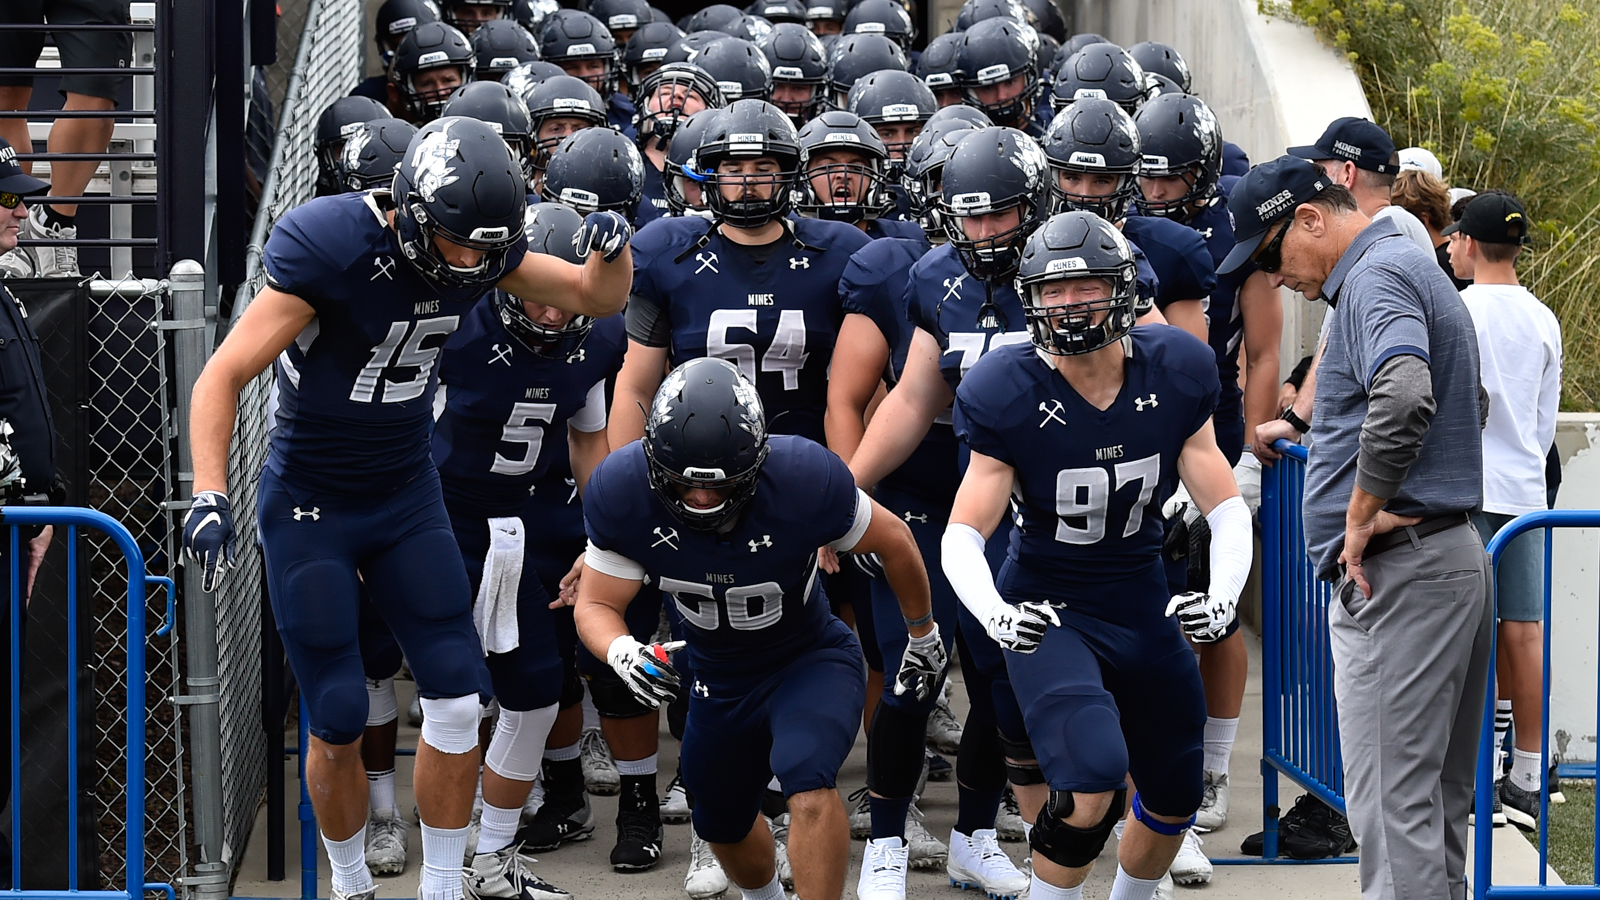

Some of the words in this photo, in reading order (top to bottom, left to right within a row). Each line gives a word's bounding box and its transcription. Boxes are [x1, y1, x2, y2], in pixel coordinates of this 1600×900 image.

[1076, 155, 1097, 163] MINES
[961, 196, 981, 204] MINES
[1255, 189, 1292, 216] MINES
[1260, 198, 1296, 222] FOOTBALL
[480, 230, 504, 239] MINES
[1053, 259, 1077, 270] MINES
[747, 293, 774, 306] MINES
[413, 300, 440, 315] MINES
[349, 315, 460, 403] 15
[525, 387, 551, 399] MINES
[489, 402, 557, 476] 5
[1095, 444, 1124, 460] MINES
[690, 470, 716, 479] MINES
[1054, 452, 1160, 545] 97
[705, 573, 735, 584] MINES
